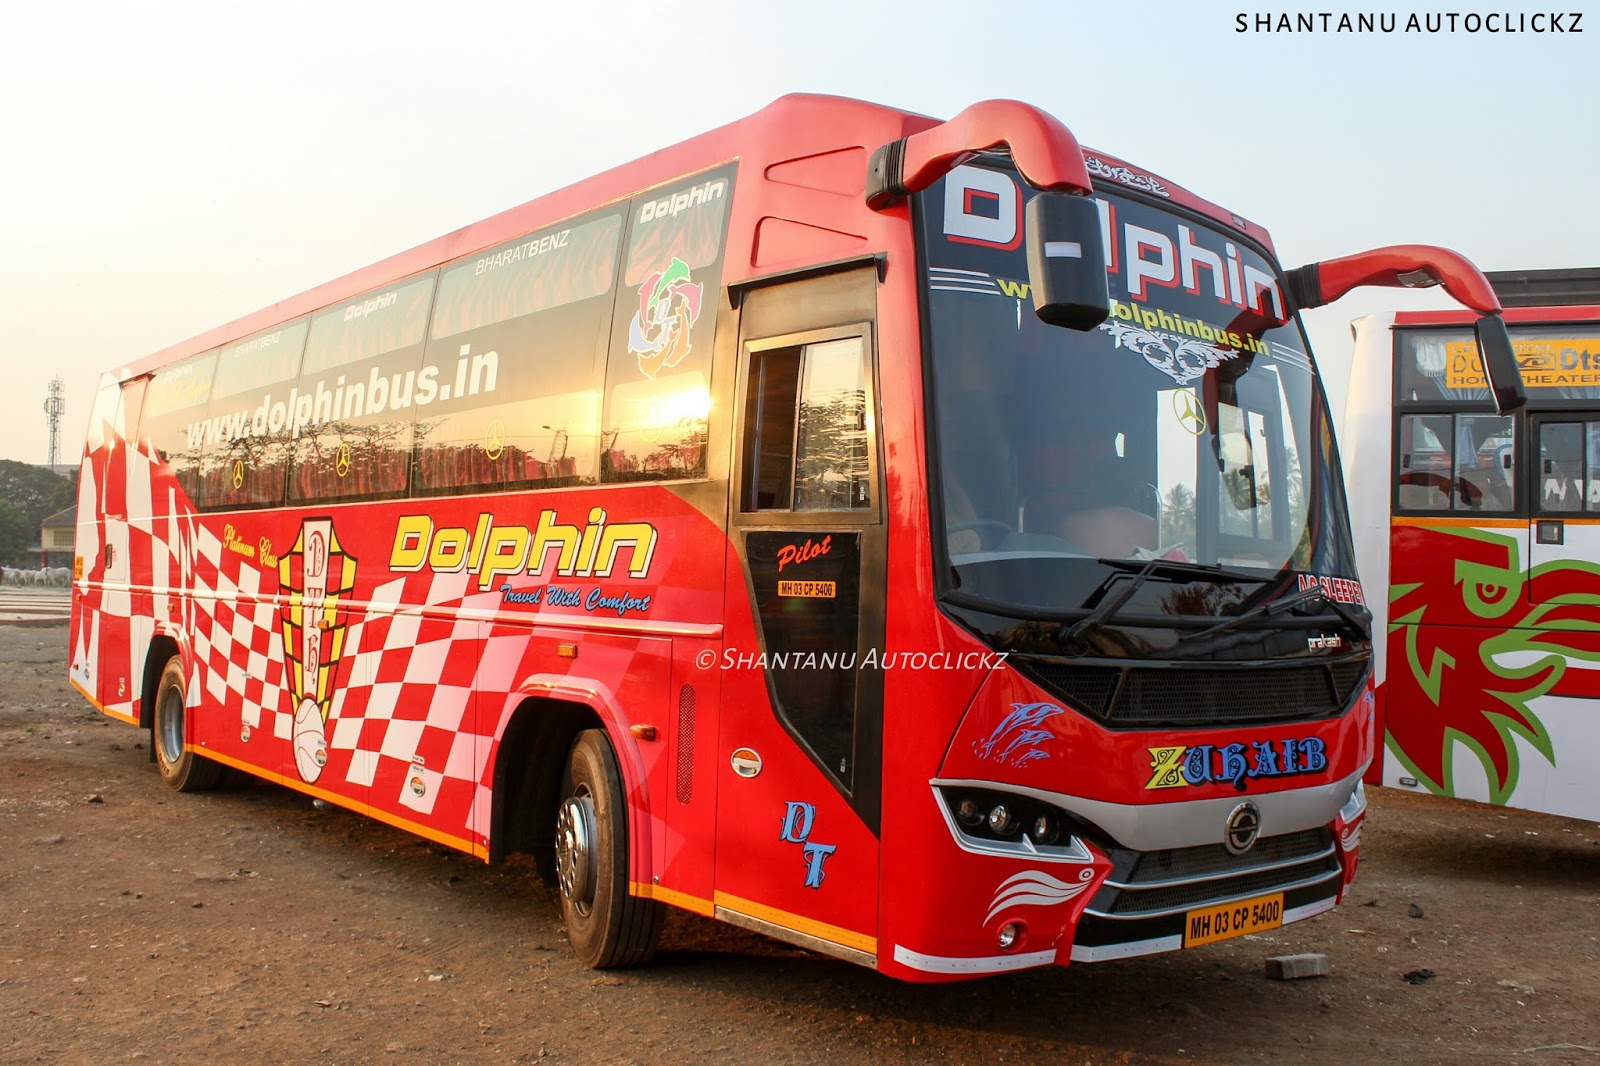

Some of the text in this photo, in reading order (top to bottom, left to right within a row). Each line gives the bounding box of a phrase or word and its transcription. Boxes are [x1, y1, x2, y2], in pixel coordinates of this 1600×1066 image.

[640, 181, 724, 224] Dolphin
[475, 229, 571, 275] BHARATBENZ
[943, 165, 1288, 325] Dlphin
[344, 293, 398, 322] Dolphin
[186, 343, 500, 449] www.dolphinbus.in
[223, 524, 255, 559] Platinum
[389, 507, 658, 592] Dolphin
[777, 535, 832, 573] Pilot
[500, 583, 651, 616] Travel With Comfort
[781, 582, 833, 597] MH 03 CP 5400
[1307, 633, 1342, 652] prakash
[1190, 900, 1279, 939] MH 03 CP 5400
